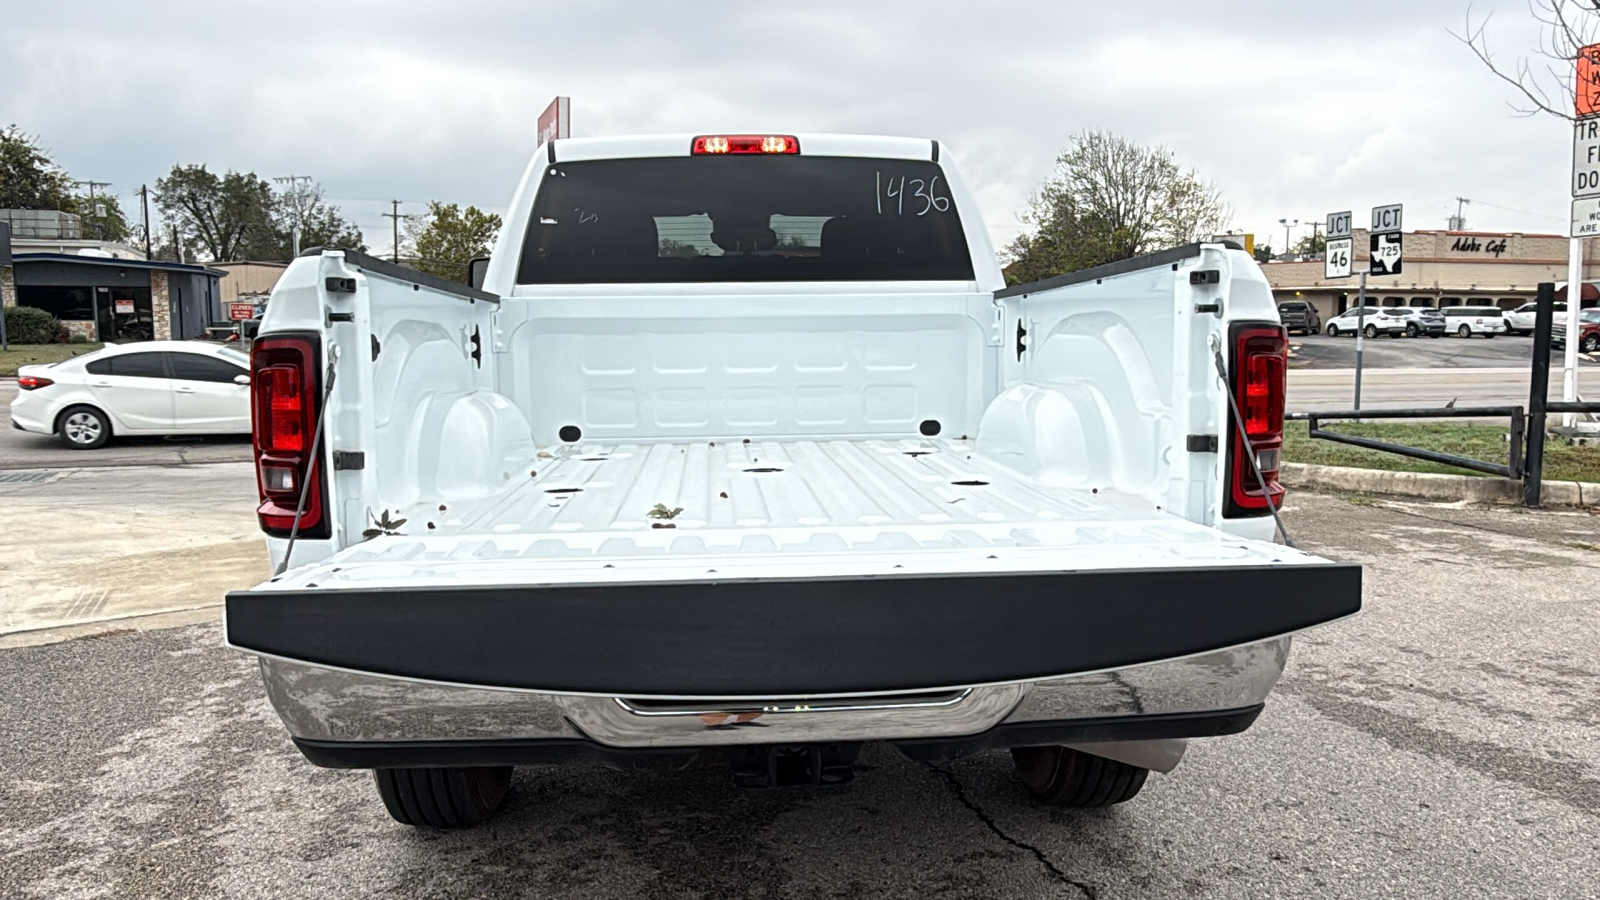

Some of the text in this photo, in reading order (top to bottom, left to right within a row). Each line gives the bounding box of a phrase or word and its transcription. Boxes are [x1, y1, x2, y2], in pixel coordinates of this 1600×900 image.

[876, 171, 950, 216] 1436
[1328, 215, 1351, 234] JCT
[1373, 208, 1401, 229] JCT
[1579, 223, 1598, 233] ARE
[1329, 241, 1349, 250] BUSINESS
[1380, 245, 1398, 257] 725
[1451, 236, 1482, 252] Adobe
[1330, 251, 1348, 268] 46
